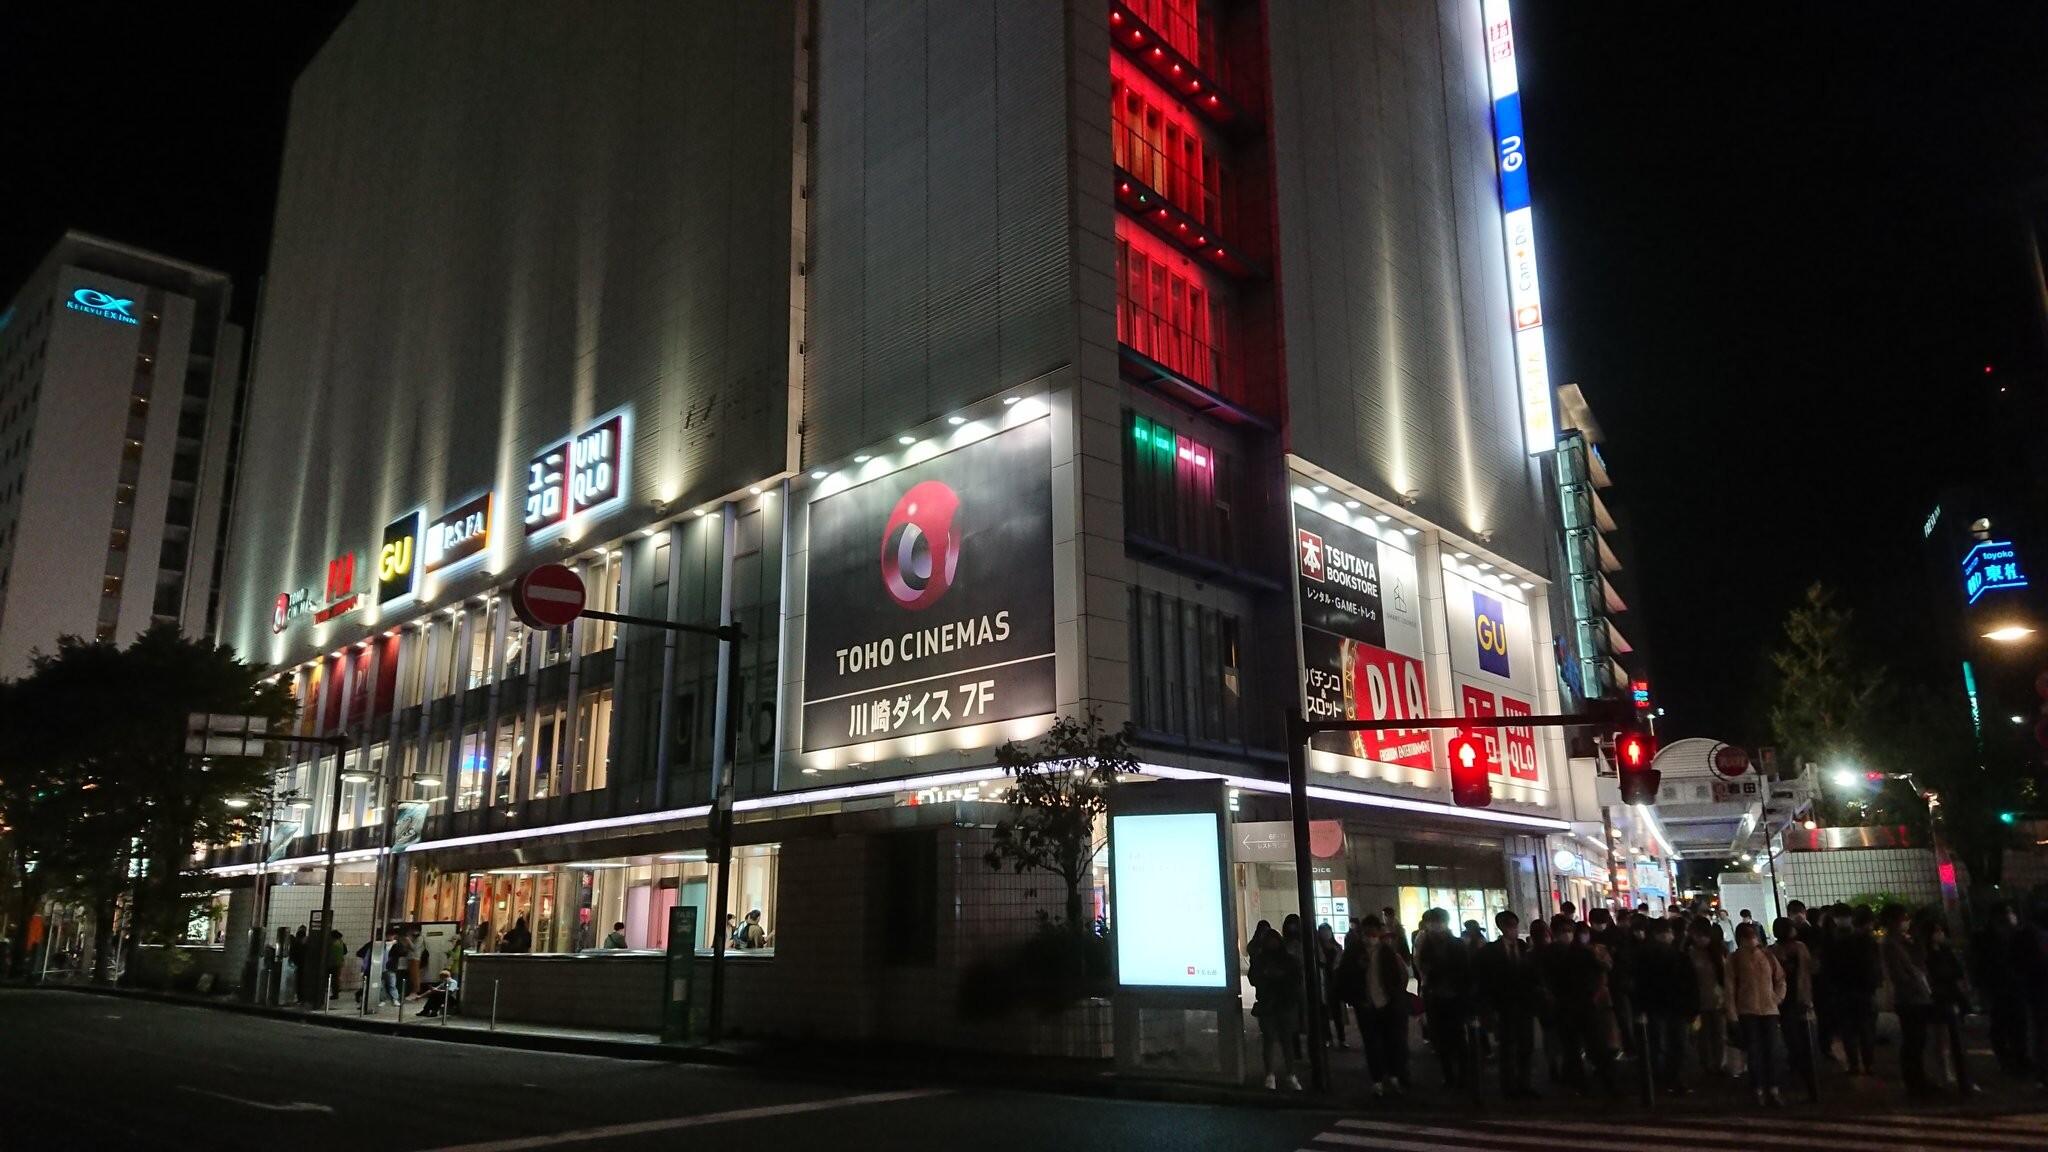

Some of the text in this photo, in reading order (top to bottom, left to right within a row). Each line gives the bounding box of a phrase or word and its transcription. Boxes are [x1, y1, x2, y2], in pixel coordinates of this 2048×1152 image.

[1502, 135, 1523, 172] GU
[66, 300, 137, 326] KEIKYU EX INN
[575, 429, 611, 469] UNI
[528, 454, 564, 492] ユニ
[574, 462, 611, 505] QLO
[524, 486, 563, 525] クロ
[378, 536, 414, 583] GU
[1302, 538, 1321, 573] 本
[1325, 543, 1377, 582] TSUTAYA
[1982, 550, 2014, 561] toyoko
[1326, 566, 1379, 598] BOOKSTORE
[836, 610, 1011, 676] TOHO CINEMAS
[1478, 614, 1506, 656] GU
[1305, 667, 1341, 692] パチンコ
[848, 679, 996, 738] 川崎ダイス 7F
[1307, 696, 1343, 718] スロット
[1365, 661, 1430, 741] PIA
[1506, 708, 1530, 739] UNI
[1510, 741, 1535, 774] QLO
